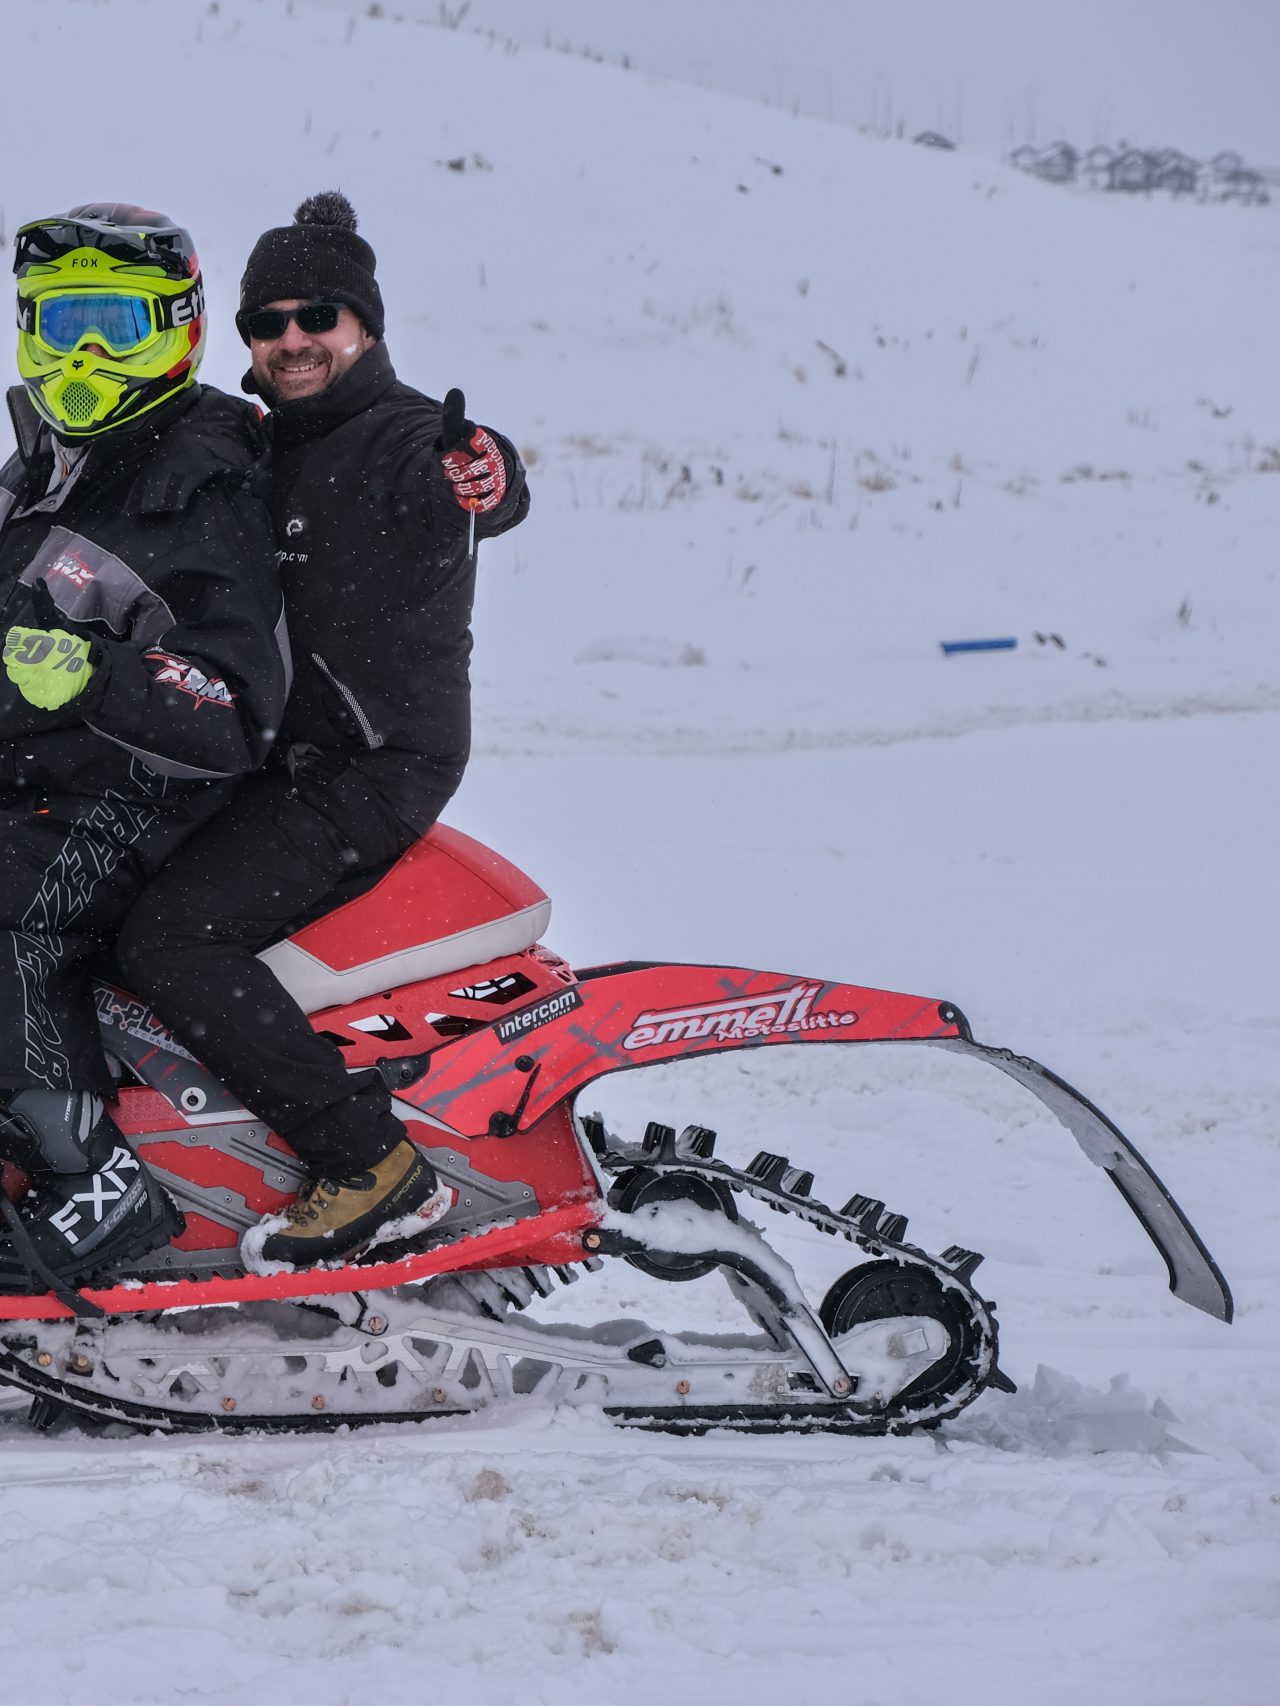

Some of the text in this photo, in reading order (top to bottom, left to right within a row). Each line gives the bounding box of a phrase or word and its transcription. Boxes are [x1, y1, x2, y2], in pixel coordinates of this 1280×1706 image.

[71, 257, 99, 269] FOX
[499, 991, 576, 1039] intercom
[622, 981, 825, 1051] emmeti
[716, 1011, 858, 1042] Motoslitte
[48, 1146, 141, 1245] FXR
[102, 1178, 148, 1236] X-CROSS PRO
